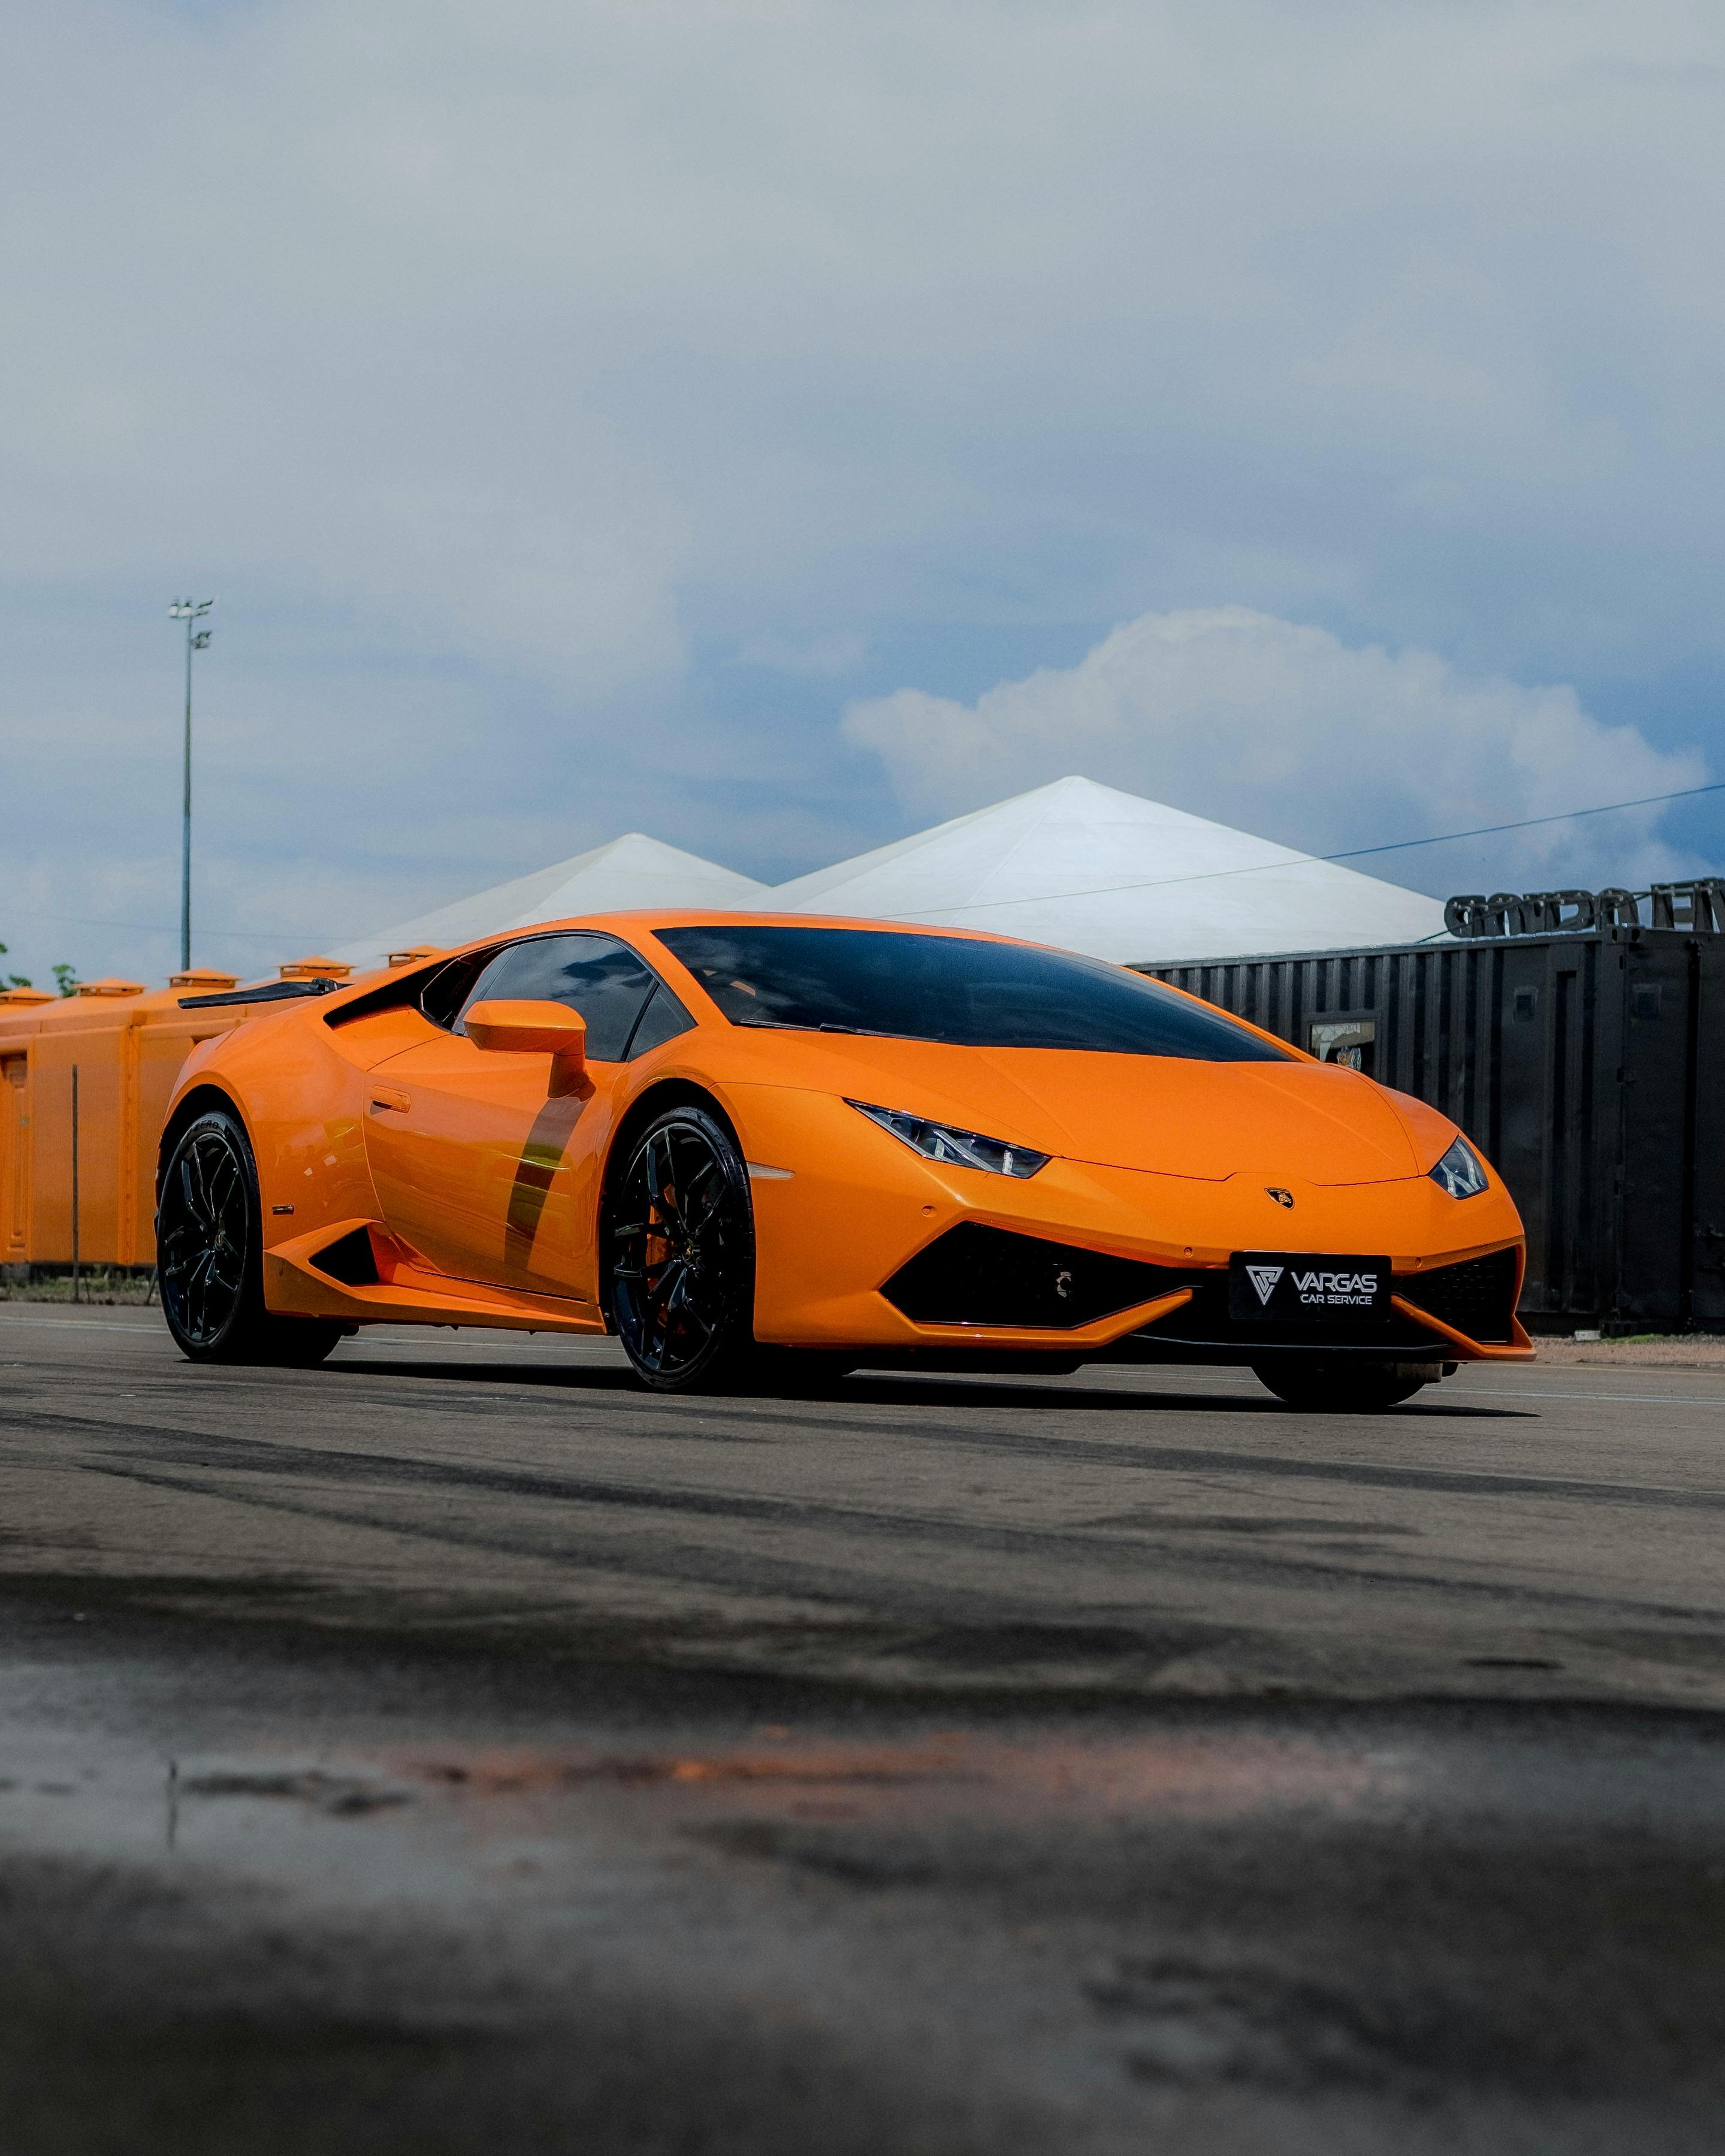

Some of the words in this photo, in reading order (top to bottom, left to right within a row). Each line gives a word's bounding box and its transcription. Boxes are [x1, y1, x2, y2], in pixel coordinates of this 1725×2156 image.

[1291, 1272, 1377, 1293] VARGAS
[1300, 1293, 1325, 1304] CAR
[1327, 1295, 1373, 1305] SERVICE
